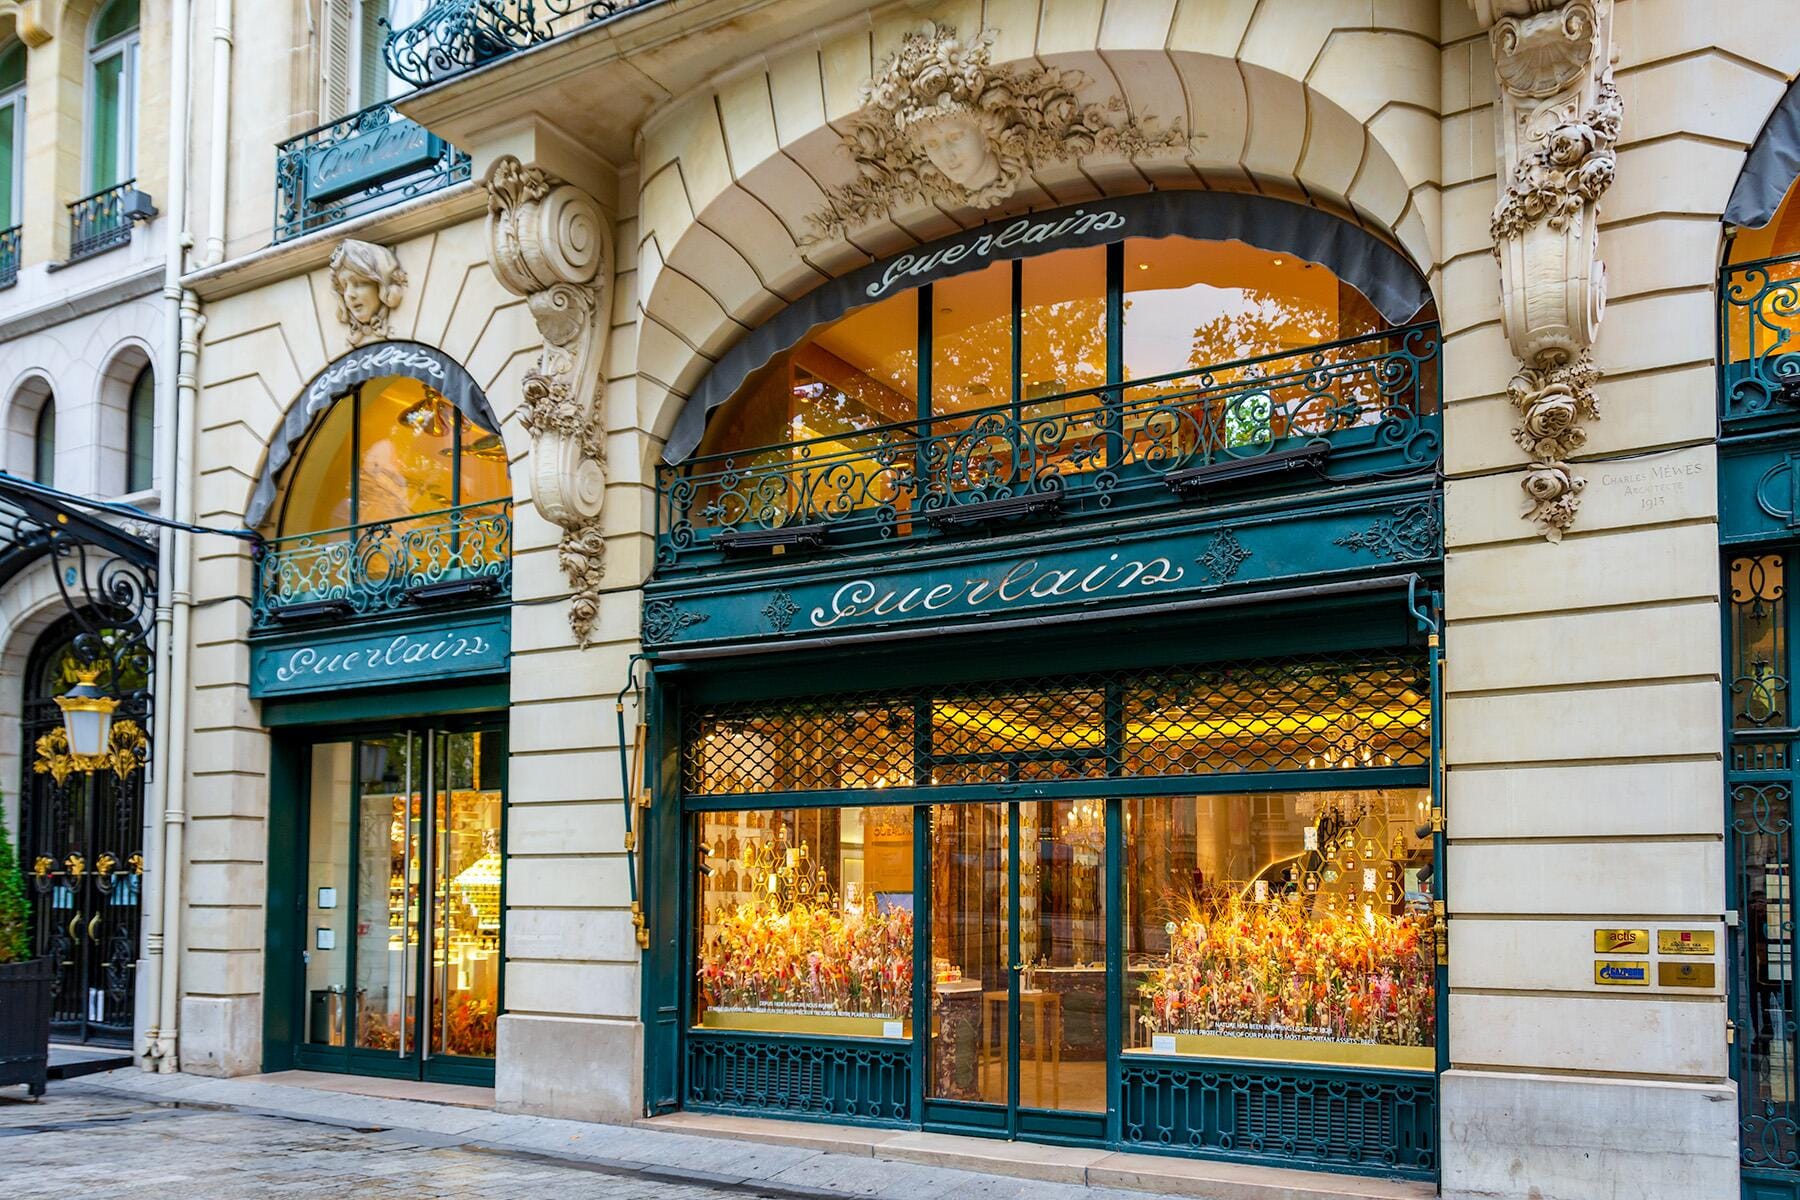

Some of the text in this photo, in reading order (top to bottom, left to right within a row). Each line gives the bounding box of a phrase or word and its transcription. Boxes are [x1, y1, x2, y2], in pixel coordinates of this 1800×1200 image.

[865, 208, 1126, 298] Guerlain
[810, 552, 1184, 628] Guerlain
[276, 632, 490, 683] Guerlain
[1609, 931, 1636, 942] actis
[1215, 1021, 1237, 1029] NATURE
[1301, 1035, 1335, 1043] IMPORTANT
